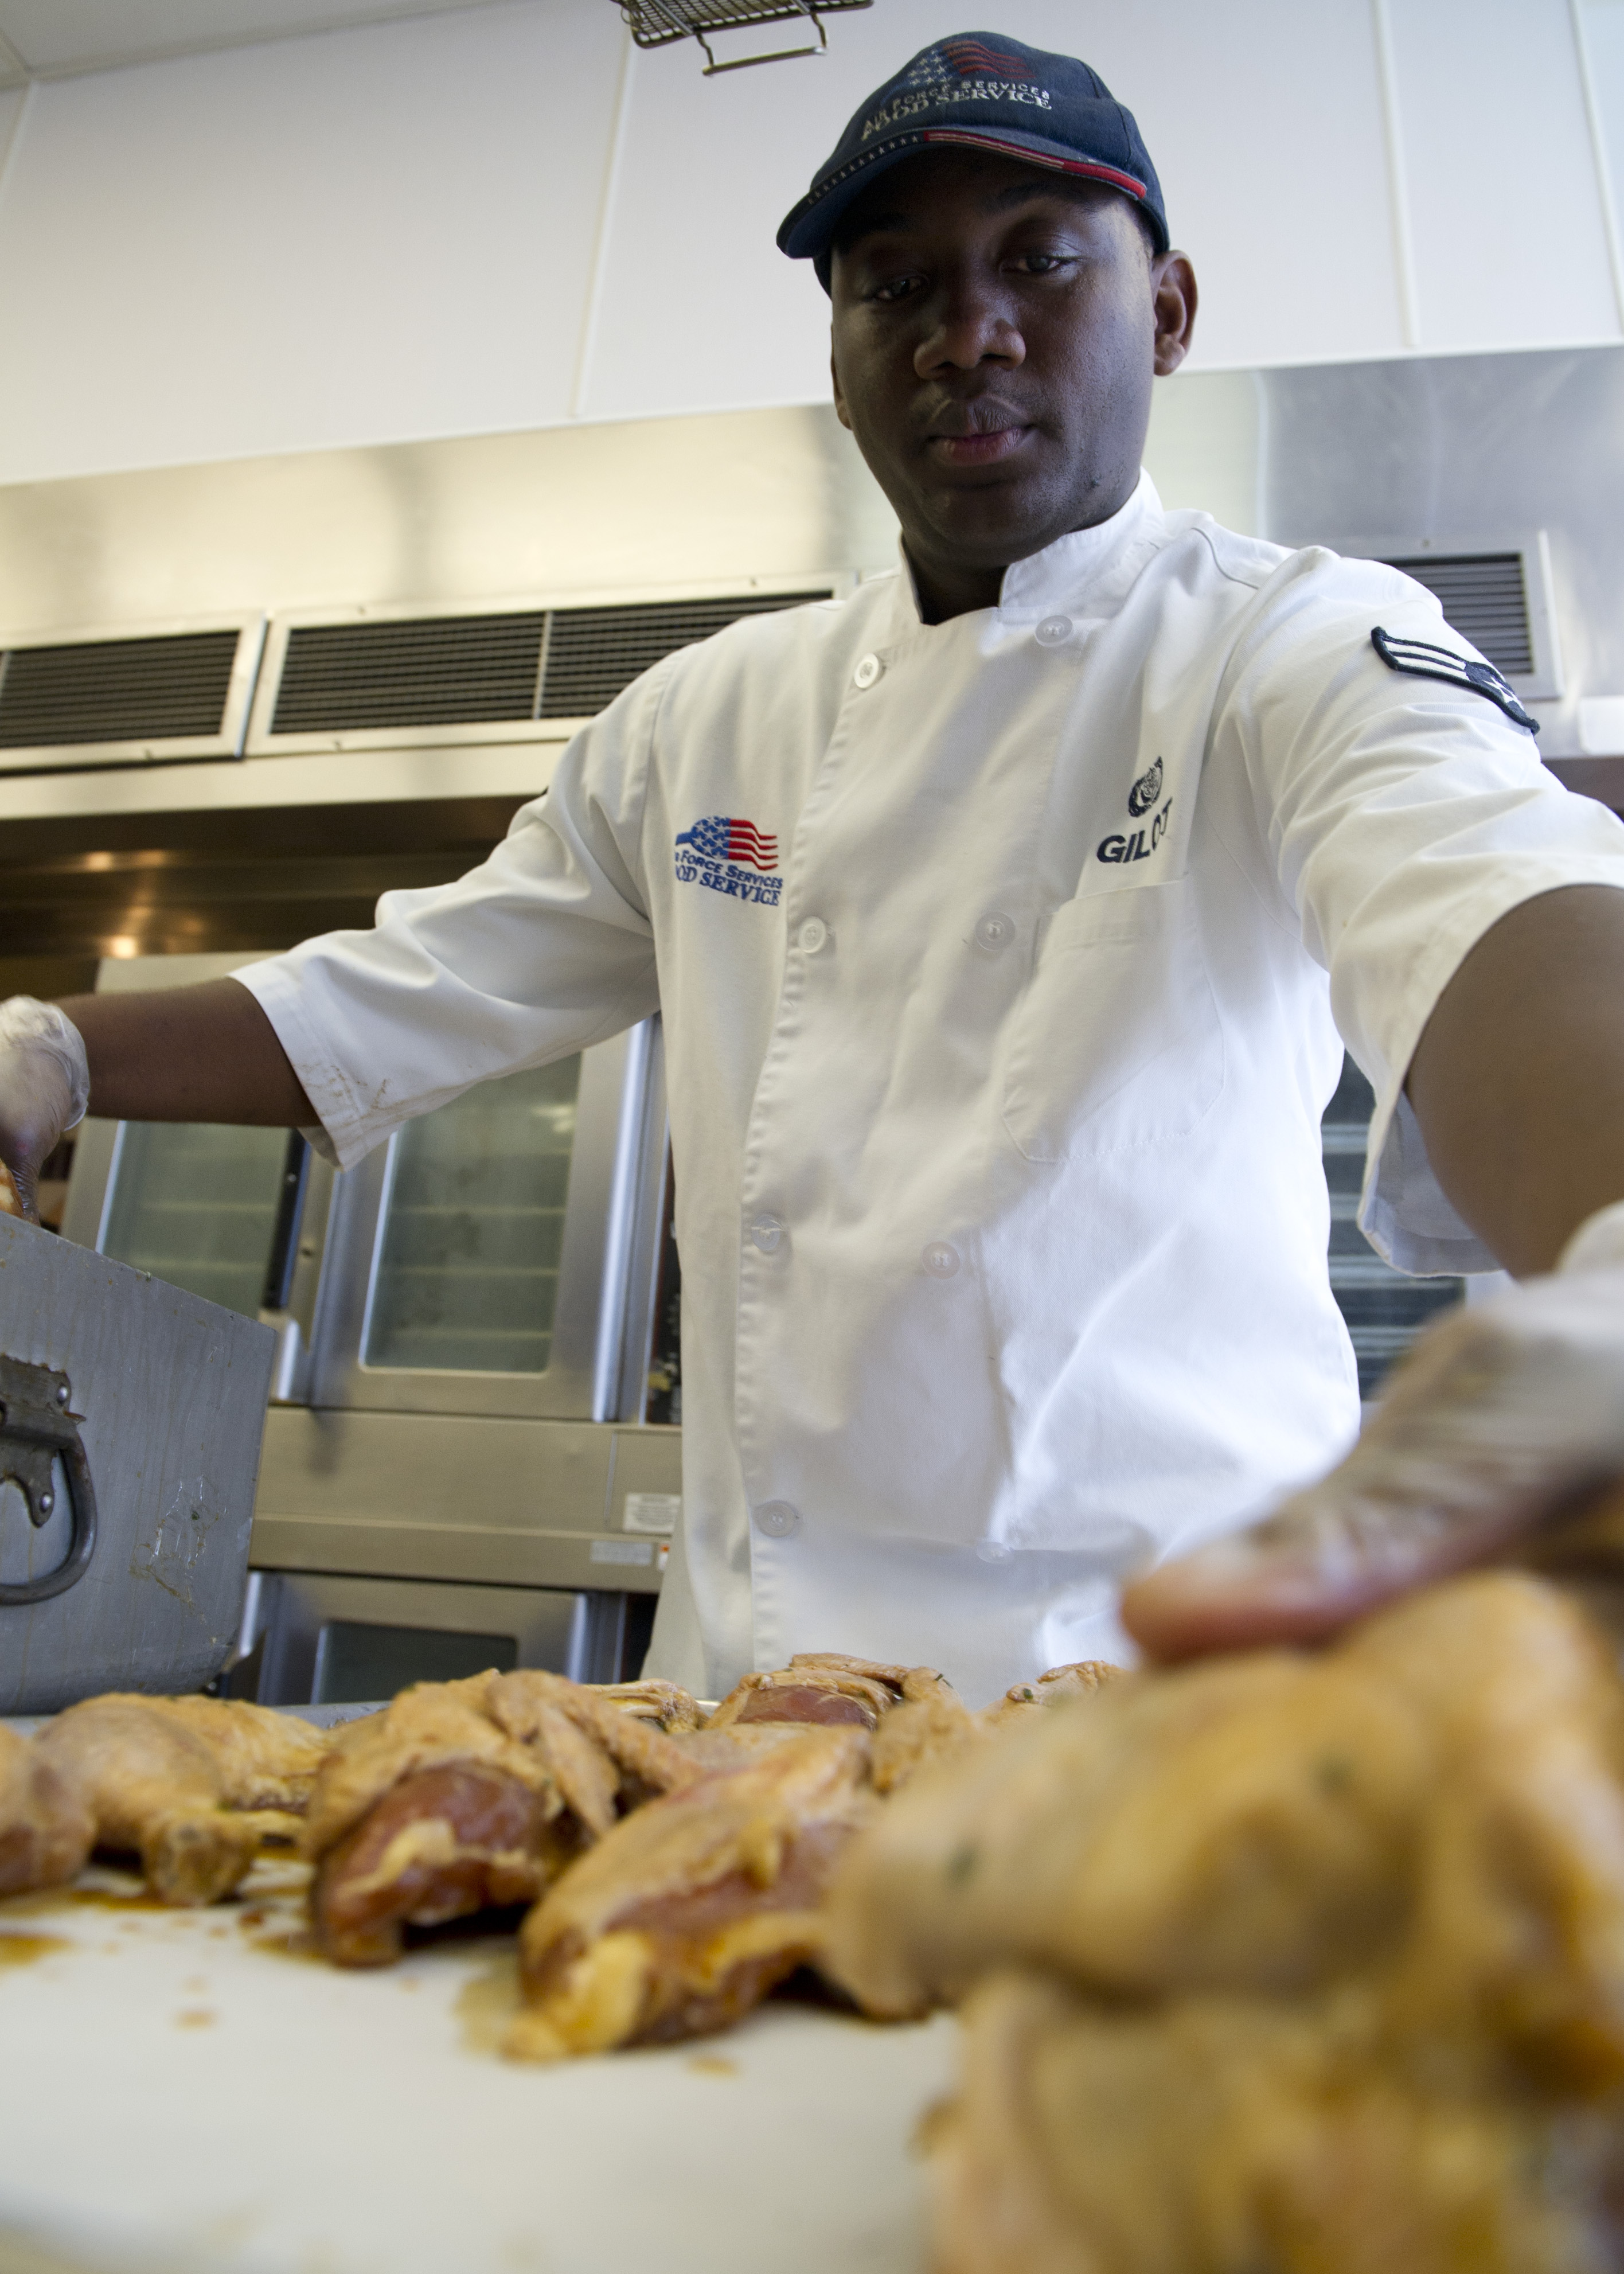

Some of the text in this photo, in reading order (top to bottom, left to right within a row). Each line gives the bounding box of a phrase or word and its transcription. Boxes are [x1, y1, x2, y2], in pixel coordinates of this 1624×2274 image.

[935, 88, 1052, 110] SERVICE
[961, 80, 1050, 100] SERVICES
[681, 850, 724, 873] FORCE
[725, 864, 783, 890] SERVICES
[699, 872, 781, 907] SERVICE
